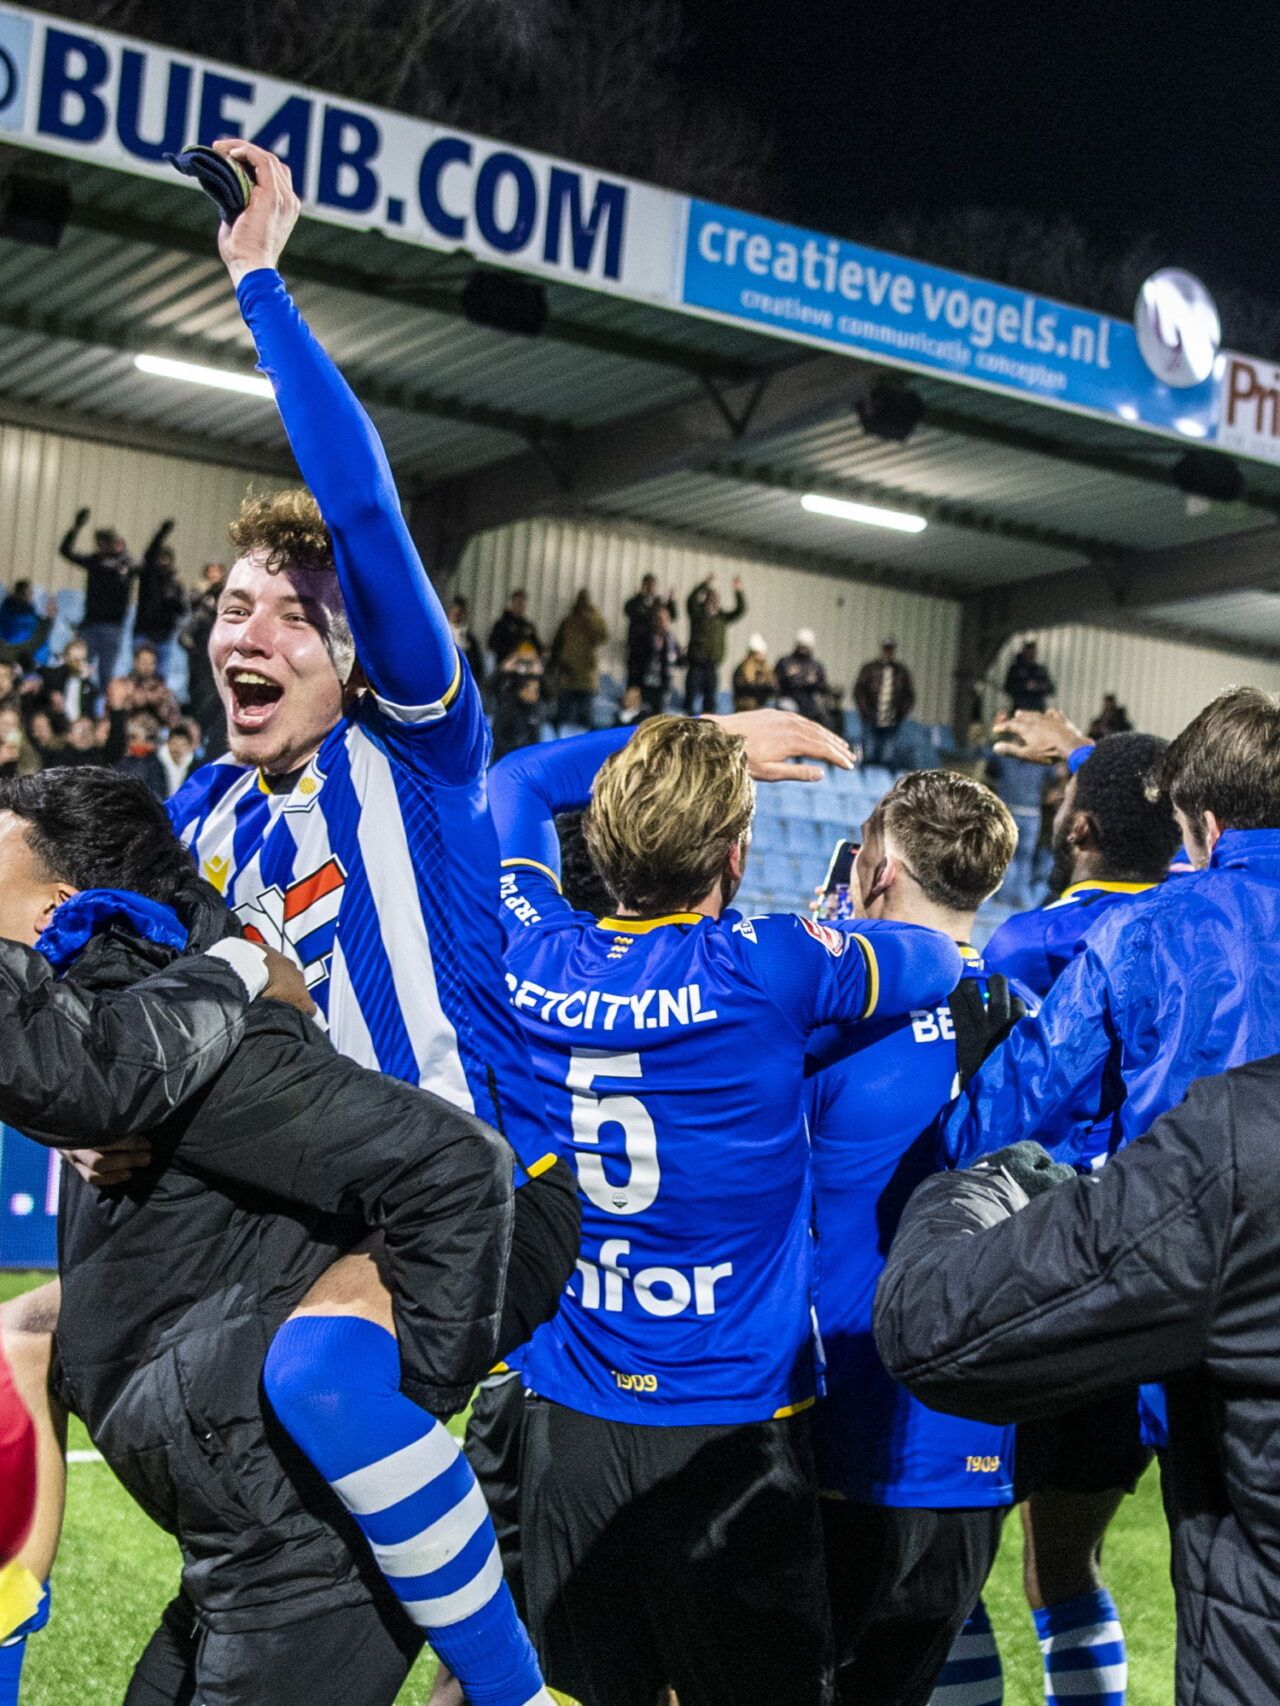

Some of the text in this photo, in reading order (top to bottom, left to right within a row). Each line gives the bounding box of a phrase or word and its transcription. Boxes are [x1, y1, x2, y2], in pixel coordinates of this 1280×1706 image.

[698, 221, 1111, 369] creatieve vogels.nl
[740, 289, 833, 331] creatieve
[837, 314, 972, 366] communicatie
[566, 1048, 661, 1215] 5
[565, 1239, 733, 1317] nfor
[611, 1369, 659, 1393] 1909
[966, 1455, 1001, 1473] 1909
